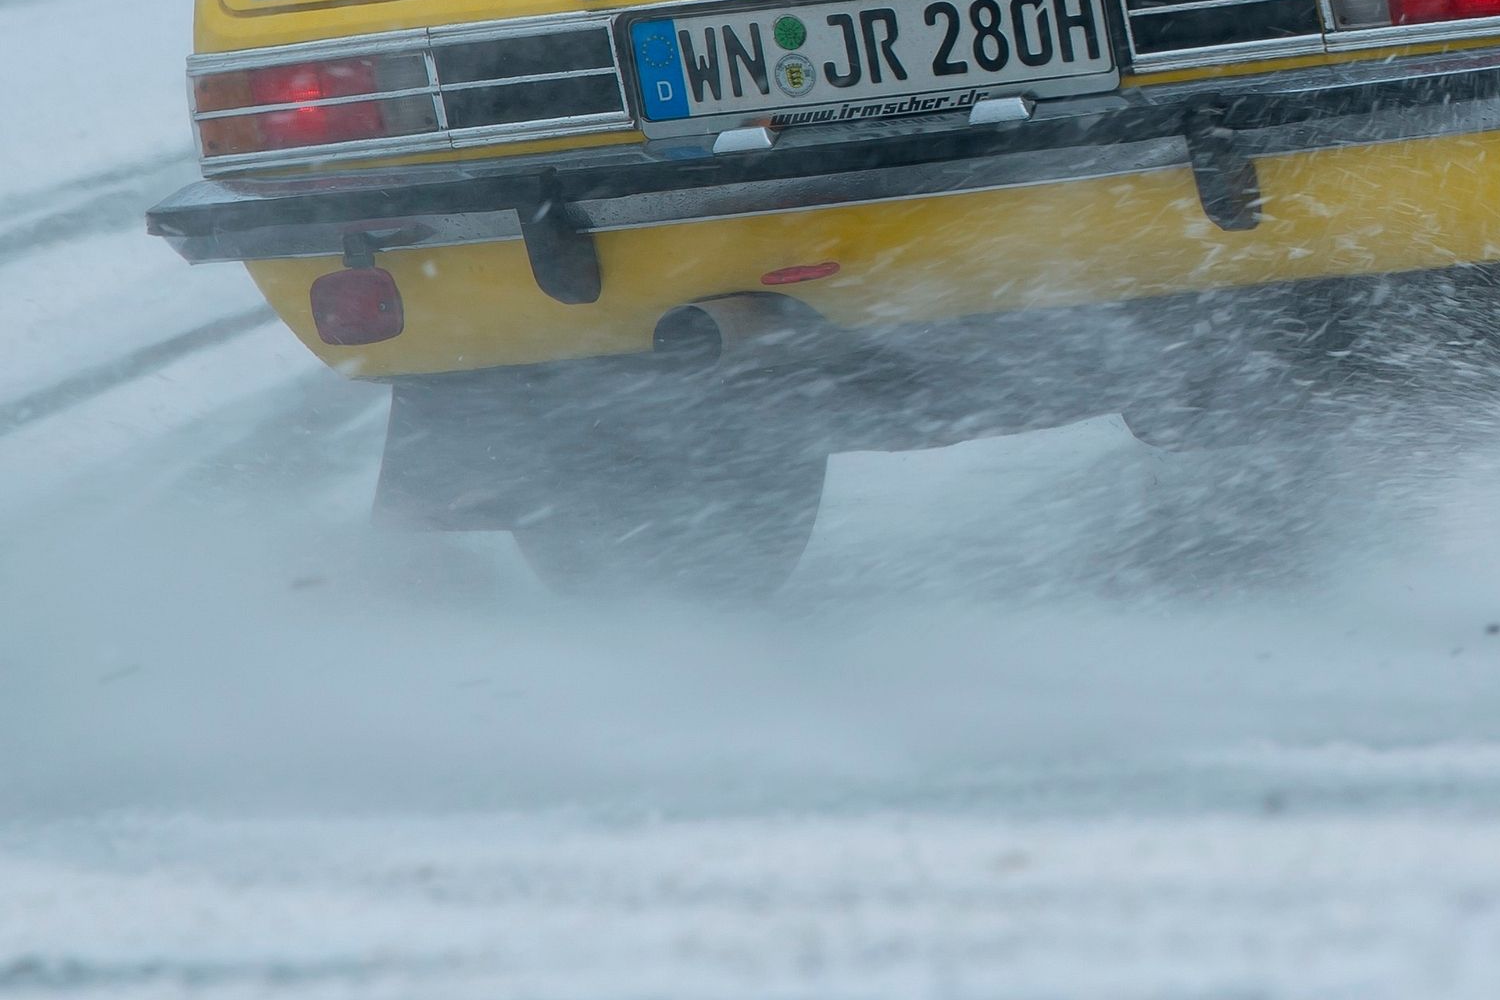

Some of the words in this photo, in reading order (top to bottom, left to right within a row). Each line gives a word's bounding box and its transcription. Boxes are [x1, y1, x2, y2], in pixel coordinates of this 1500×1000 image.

[679, 22, 769, 102] WN
[824, 8, 907, 88] JR
[656, 80, 673, 102] D
